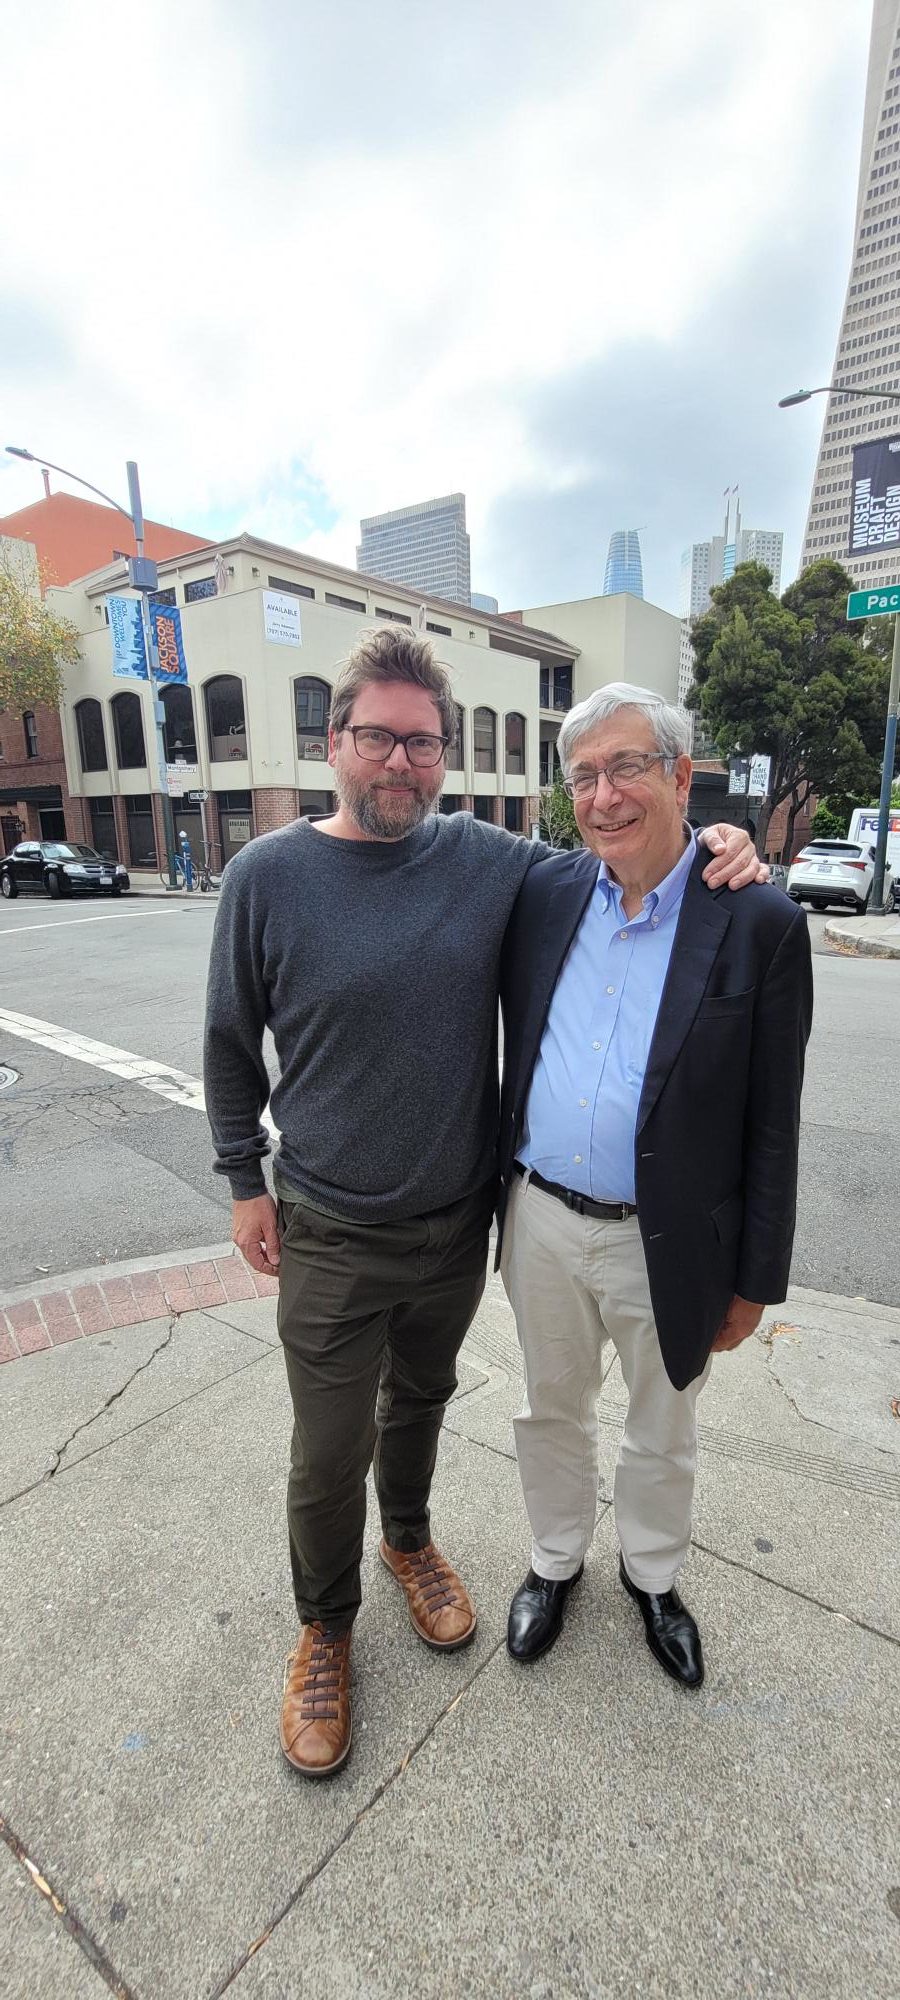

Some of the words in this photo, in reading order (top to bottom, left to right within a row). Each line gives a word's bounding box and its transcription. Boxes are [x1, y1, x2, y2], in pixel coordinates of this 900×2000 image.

[853, 478, 871, 549] MUSEUM
[867, 496, 885, 546] CRAFT
[883, 485, 900, 543] DESIGN
[109, 599, 120, 648] DOWNTOWN
[115, 600, 125, 641] WELCOMES
[266, 604, 298, 616] AVAILABLE
[867, 595, 898, 610] Pac
[156, 616, 169, 673] JACKSON
[164, 618, 179, 673] SQUARE
